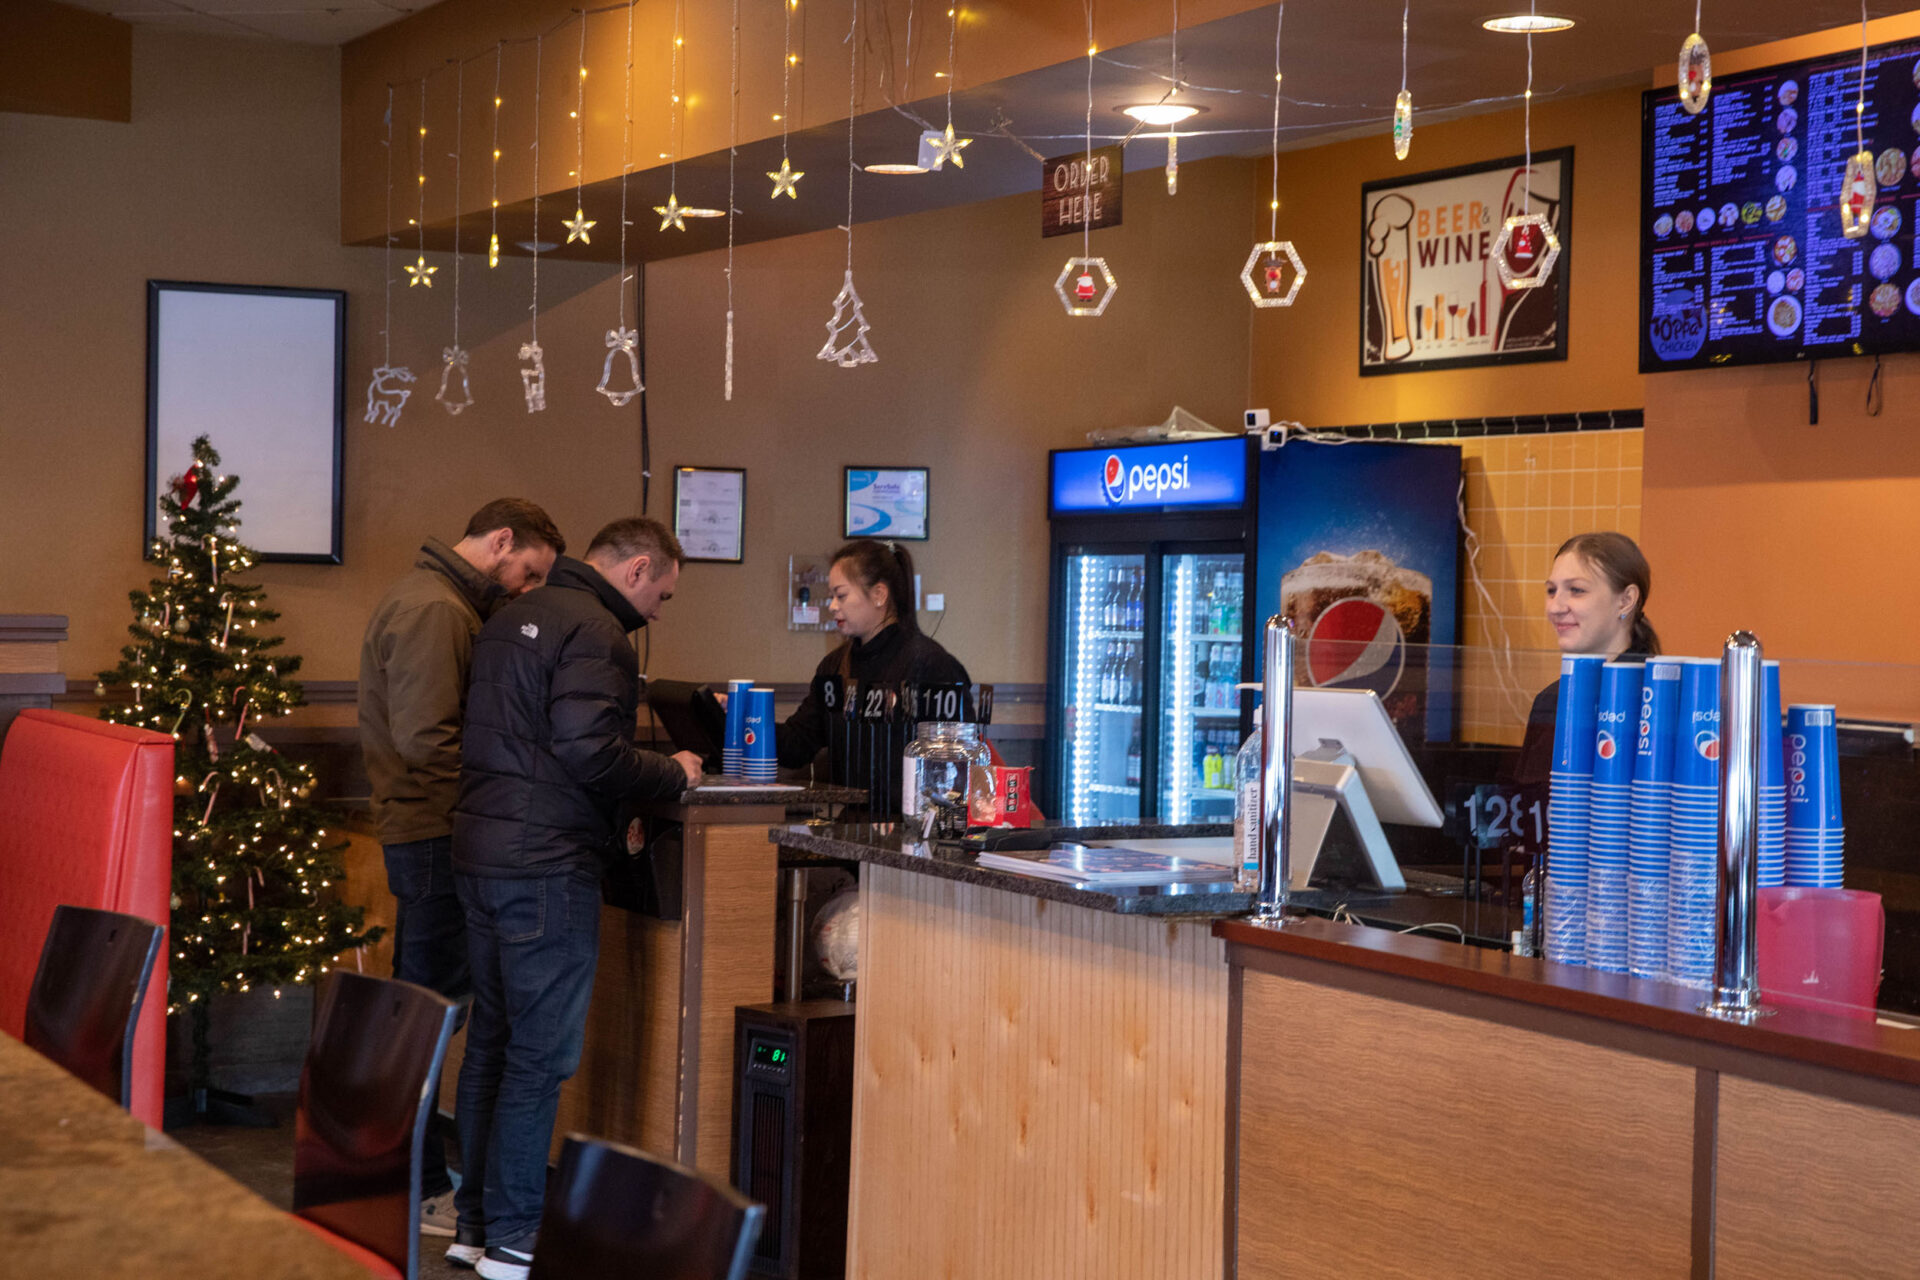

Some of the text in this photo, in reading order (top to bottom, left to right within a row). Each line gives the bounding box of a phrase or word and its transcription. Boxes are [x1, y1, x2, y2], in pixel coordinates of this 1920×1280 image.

[1053, 155, 1110, 192] ORDER
[1058, 192, 1102, 227] HERE
[1417, 201, 1483, 238] BEER
[1417, 230, 1491, 269] WINE
[1128, 454, 1189, 500] pepsi
[824, 680, 836, 707] 8
[864, 689, 883, 718] 22
[1637, 686, 1654, 757] pepsi
[1787, 733, 1810, 803] pepsi
[1247, 787, 1257, 860] hand sanitizer
